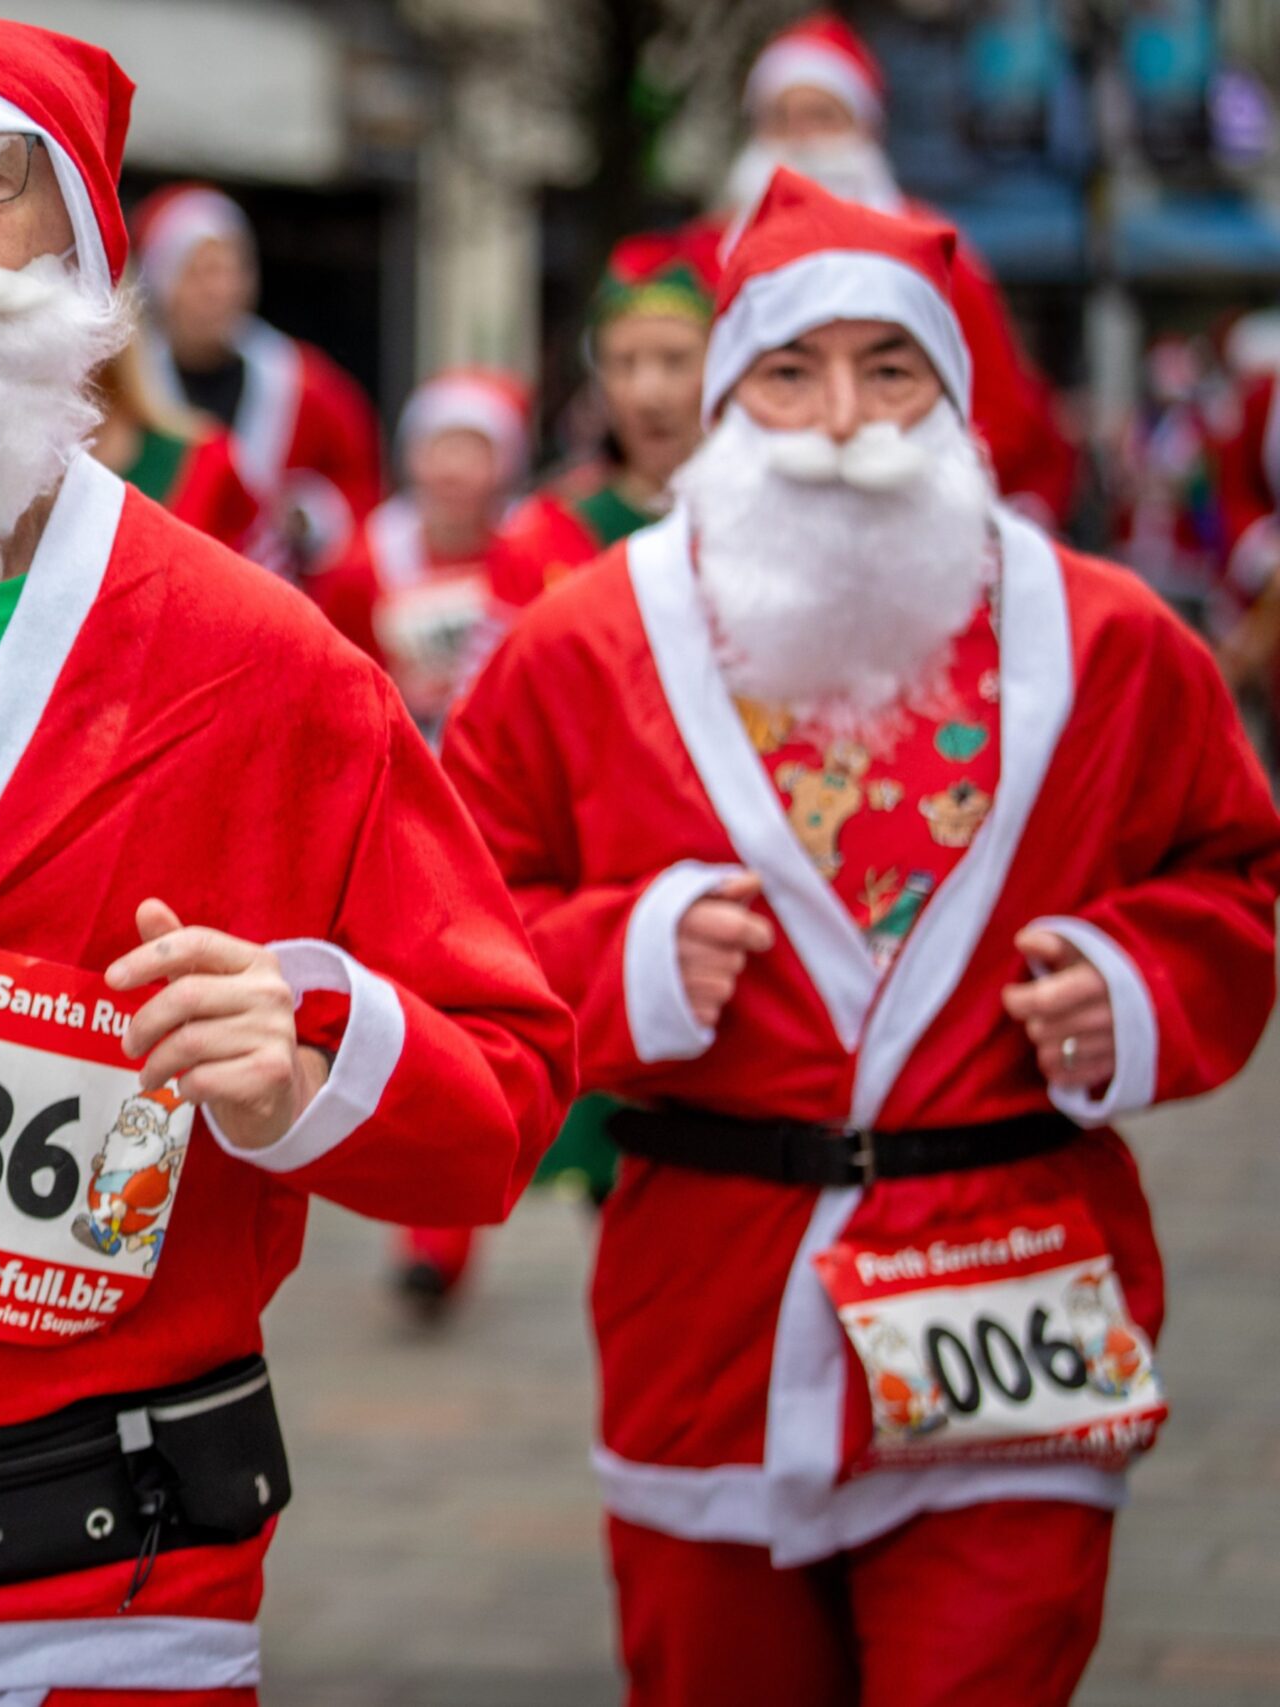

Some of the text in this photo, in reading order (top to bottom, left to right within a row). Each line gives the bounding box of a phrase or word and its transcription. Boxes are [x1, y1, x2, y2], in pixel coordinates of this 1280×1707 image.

[91, 999, 131, 1038] Ru
[927, 1240, 1009, 1275] Santa
[1008, 1224, 1066, 1261] Run
[929, 1306, 1087, 1413] 006
